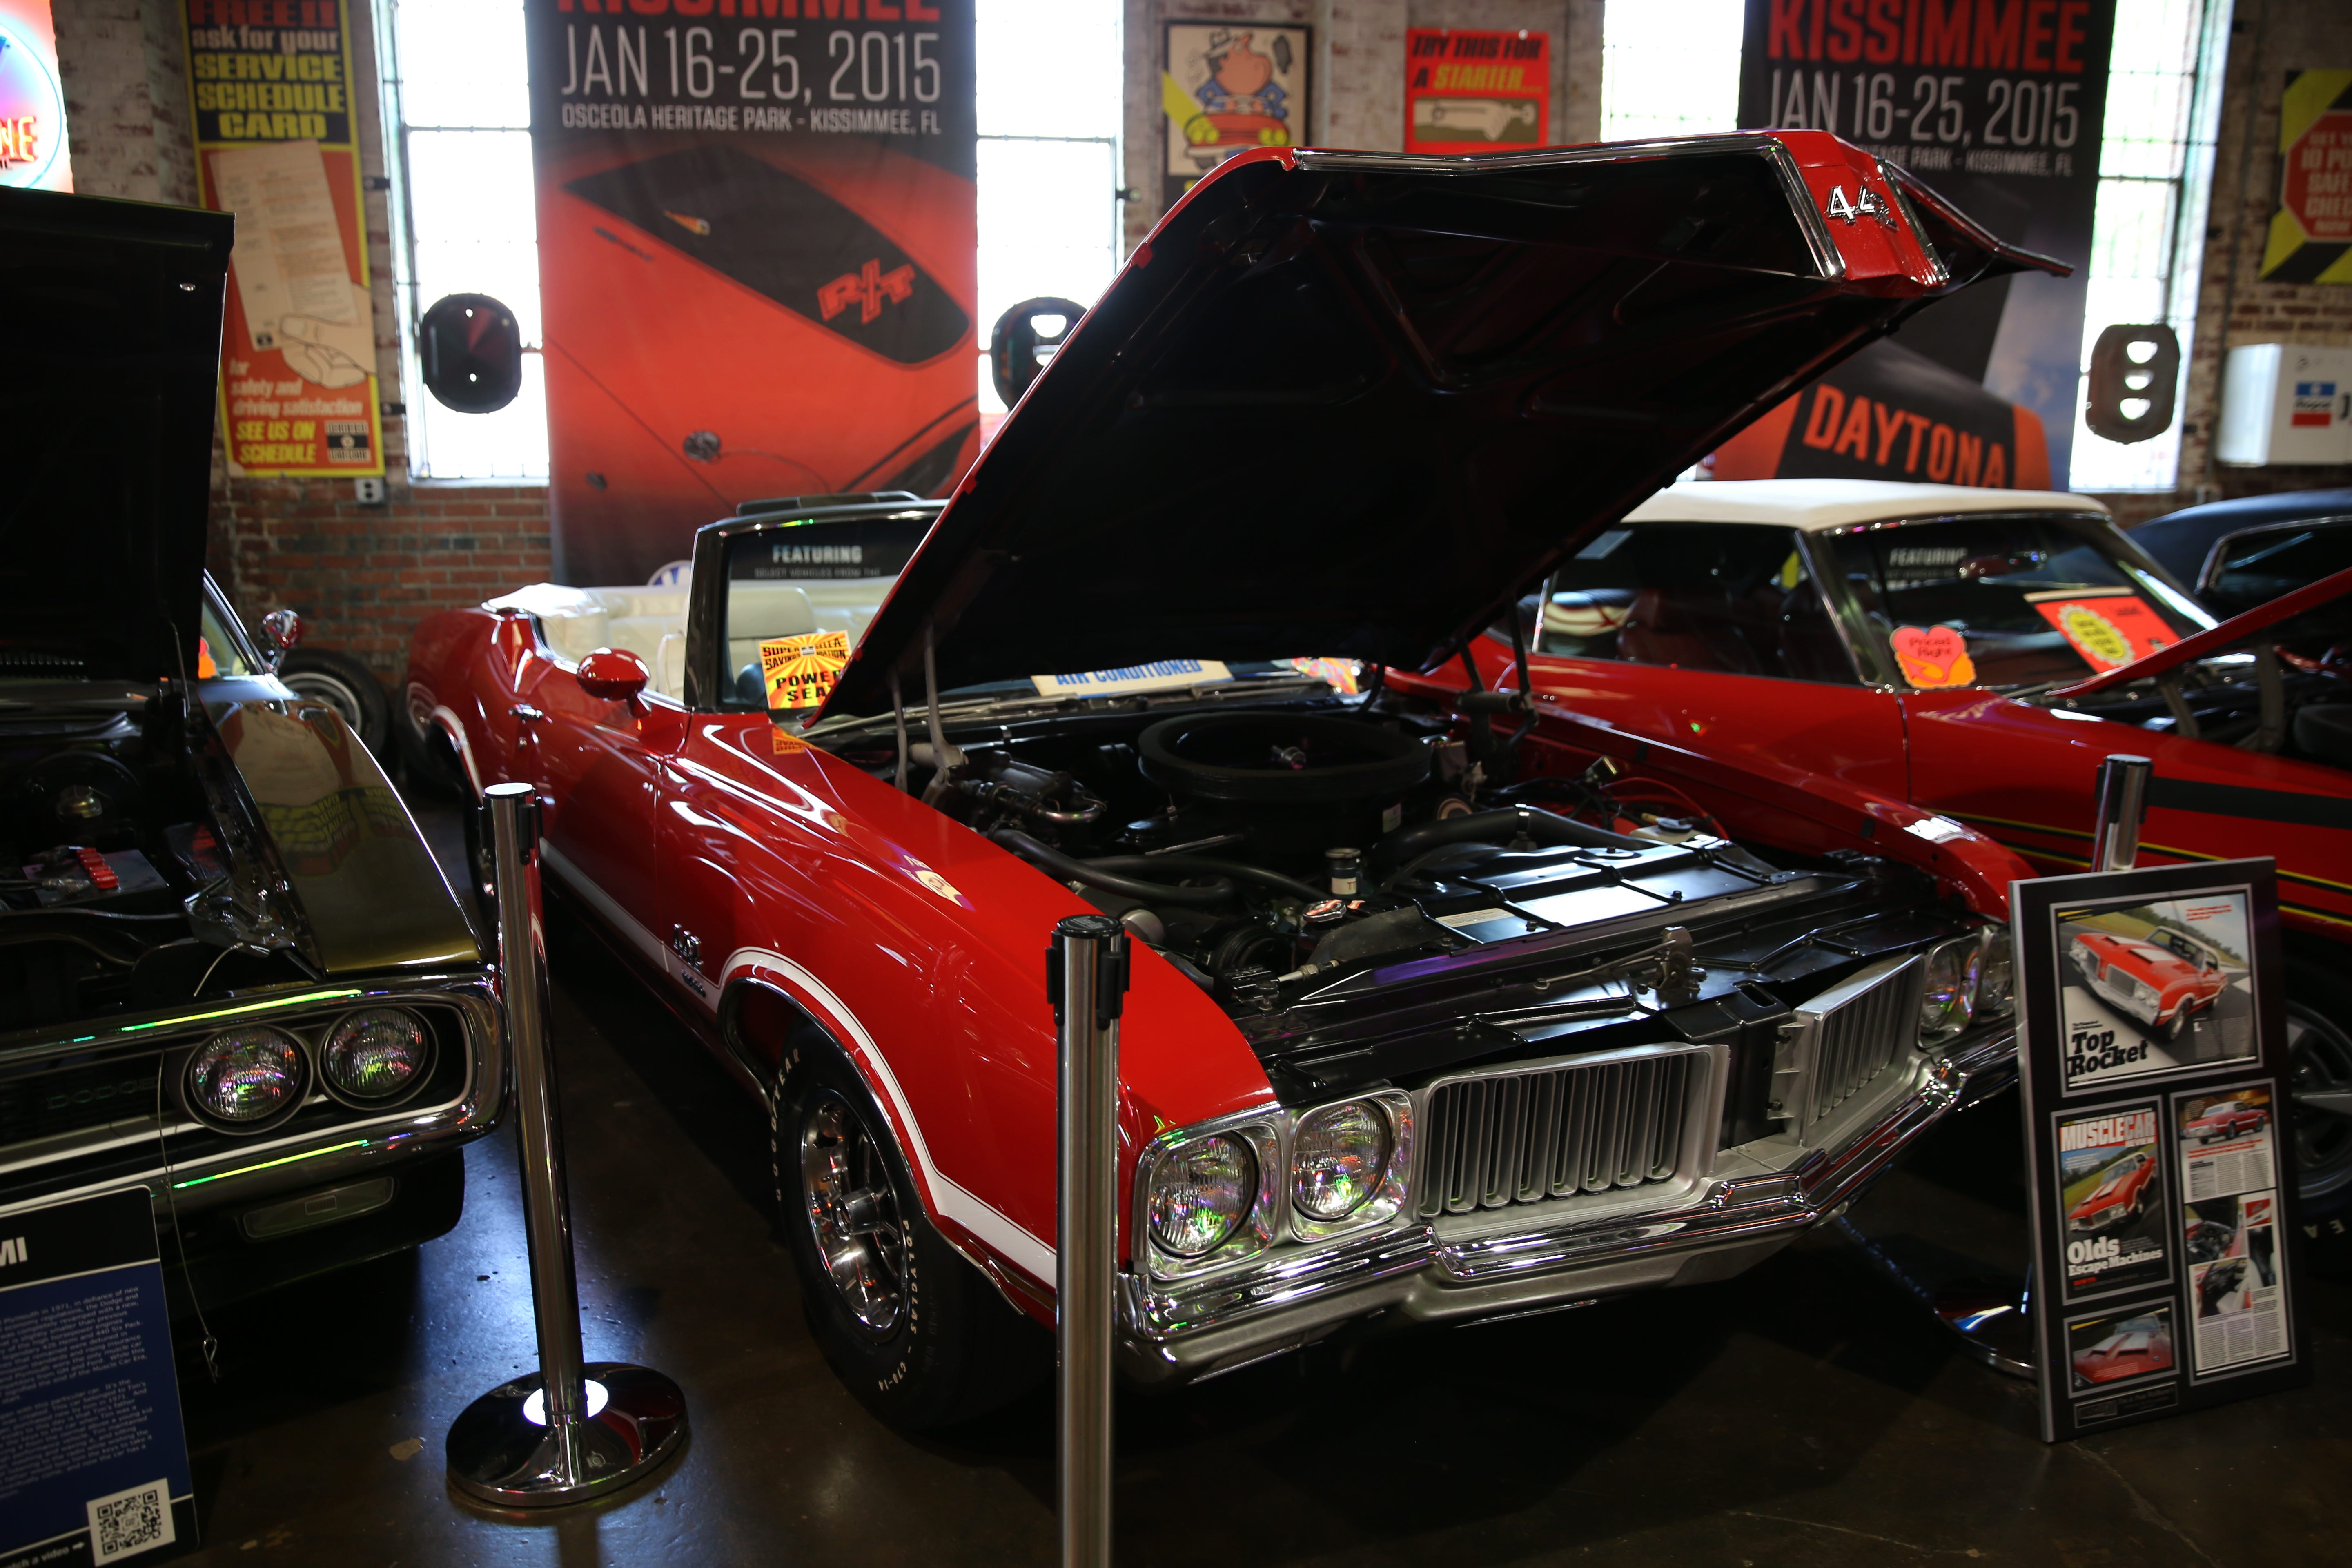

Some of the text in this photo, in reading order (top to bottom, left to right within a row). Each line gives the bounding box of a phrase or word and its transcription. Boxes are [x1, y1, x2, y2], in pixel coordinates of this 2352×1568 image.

[192, 23, 338, 54] ask for your
[1413, 37, 1541, 59] TRY THIS FOR
[1767, 0, 2090, 74] KISSIMMEE
[194, 53, 342, 80] SERVICE
[561, 24, 941, 105] JAN 16-25, 2015
[1413, 67, 1428, 88] A
[197, 83, 346, 113] SCHEDULE
[1764, 69, 2082, 148] JAN 16-25, 2015
[220, 112, 327, 140] CARD
[562, 102, 647, 129] OSCEOLA
[652, 104, 739, 131] HERITAGE
[744, 106, 793, 131] PARK
[810, 107, 916, 135] KISSIMMEE,
[921, 109, 942, 134] FL
[1911, 145, 1953, 171] PARK
[2055, 153, 2074, 177] FL
[817, 258, 916, 324] R/T
[235, 420, 265, 441] SEE
[267, 420, 290, 441] US
[292, 420, 317, 441] ON
[1802, 383, 2006, 489] DAYTONA
[239, 443, 317, 464] SCHEDULE
[772, 544, 863, 564] FEATURING
[763, 646, 800, 657] SUPER
[1055, 659, 1203, 686] AIR CONDITIONED
[787, 686, 827, 702] SEA
[2072, 1030, 2114, 1055] Top
[2067, 1039, 2148, 1078] Rocket
[2067, 1236, 2120, 1264] Olds
[2067, 1249, 2163, 1277] Escape Machines
